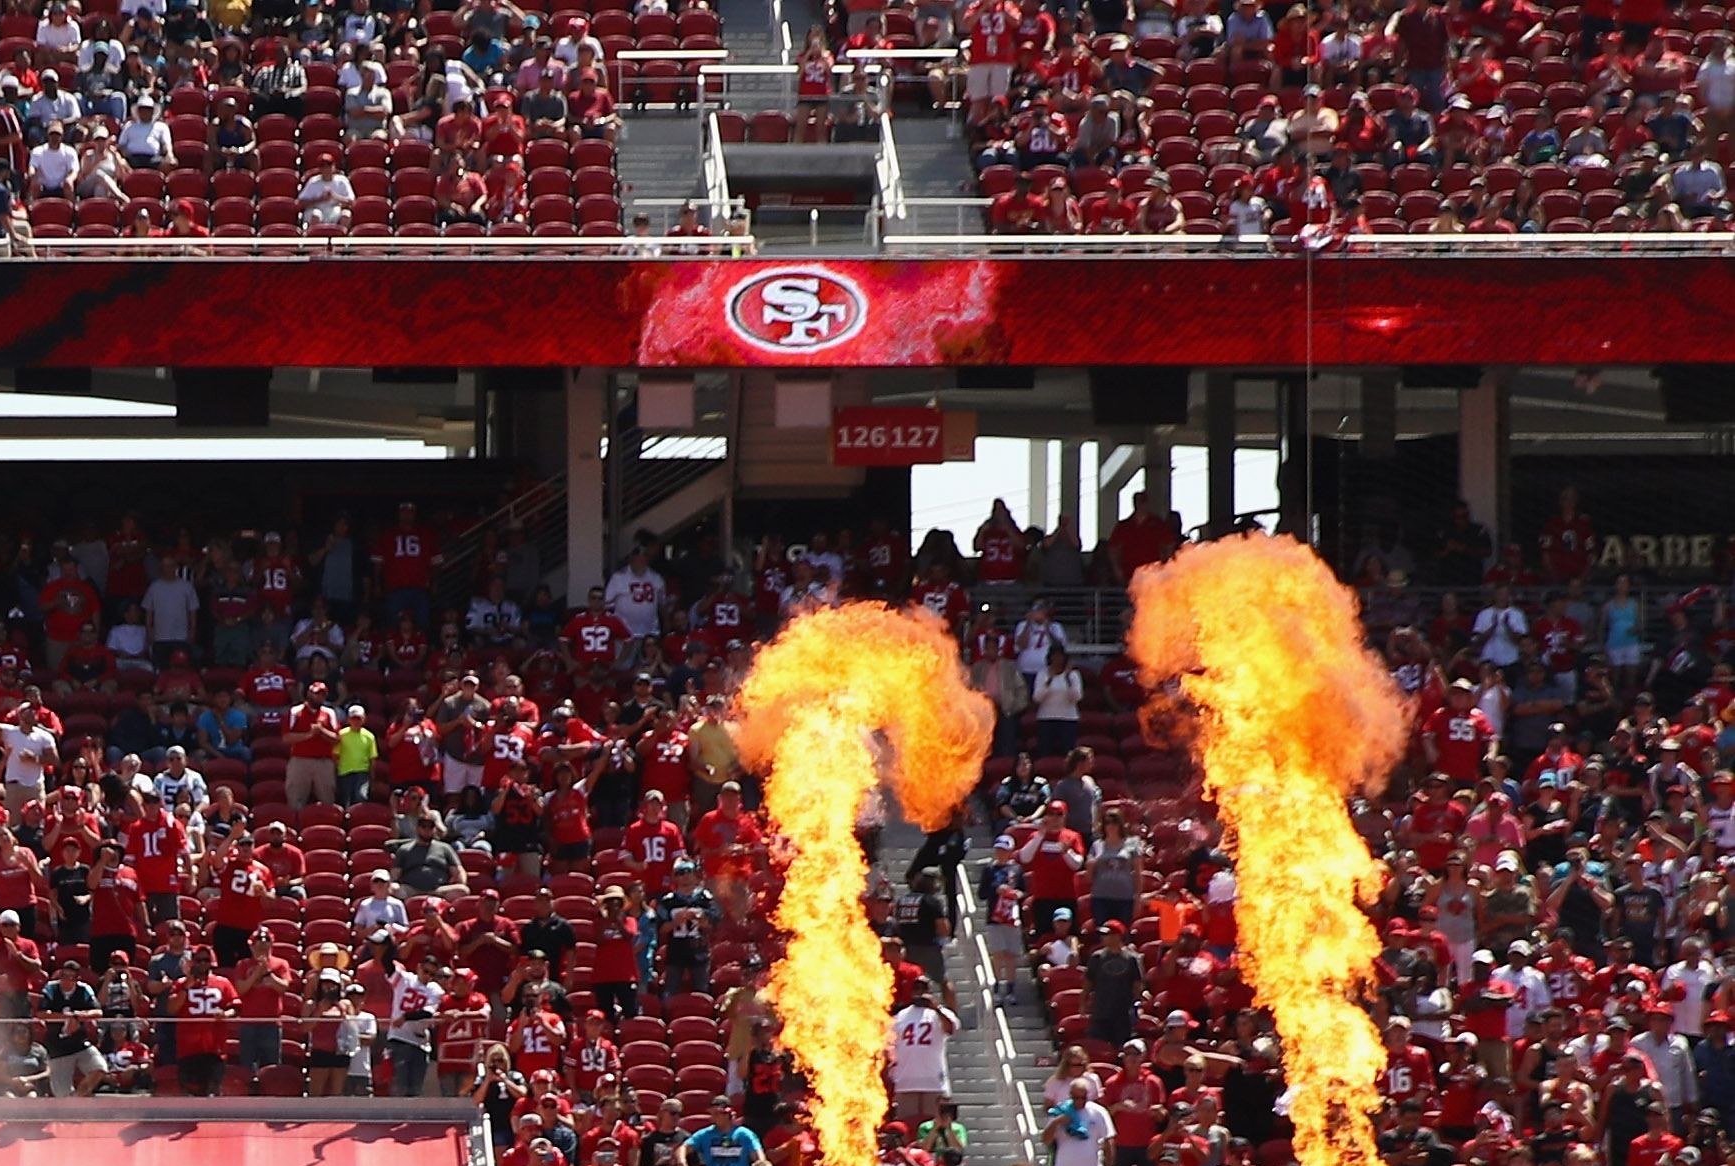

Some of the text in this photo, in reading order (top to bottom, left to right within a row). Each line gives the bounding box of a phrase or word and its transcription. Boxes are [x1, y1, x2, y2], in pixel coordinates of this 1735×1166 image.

[761, 279, 846, 346] SF
[837, 426, 939, 448] 126 127
[395, 536, 419, 556] 16
[264, 569, 287, 588] 16
[714, 604, 740, 625] 53
[581, 627, 610, 652] 52
[494, 734, 524, 759] 53
[643, 837, 665, 862] 16
[188, 988, 219, 1015] 52
[400, 990, 428, 1012] 29
[902, 1023, 931, 1047] 42
[581, 1050, 607, 1072] 93
[1386, 1066, 1413, 1094] 16
